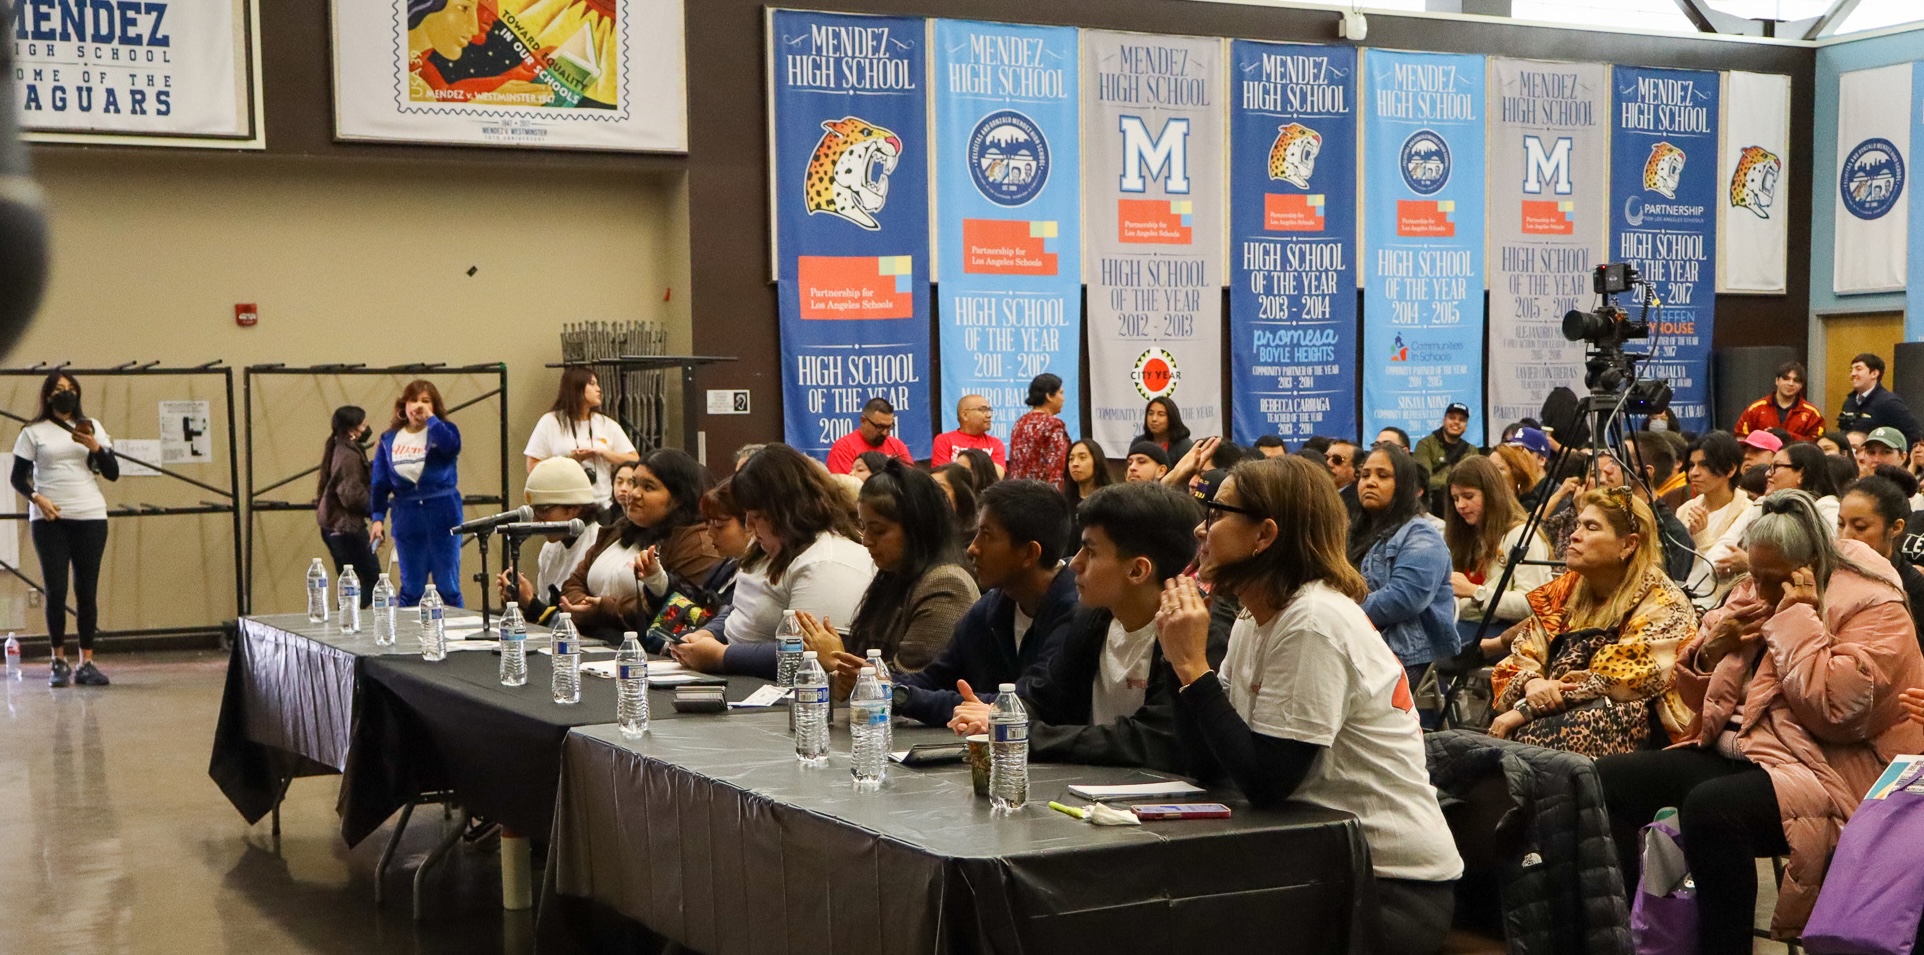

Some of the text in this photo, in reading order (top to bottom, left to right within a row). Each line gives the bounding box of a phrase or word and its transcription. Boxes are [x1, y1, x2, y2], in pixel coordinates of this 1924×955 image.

[503, 9, 588, 91] TOWARD EQUALITY
[811, 23, 889, 59] MENDEZ
[970, 33, 1044, 68] MENDEZ
[77, 46, 170, 62] SCHOOL
[499, 27, 581, 105] IN OUR SCHOOLS
[1120, 44, 1188, 76] MENDEZ
[16, 68, 171, 87] OME OF THE
[409, 50, 423, 97] USA 39
[787, 55, 915, 89] HIGH SCHOOL
[949, 62, 1067, 98] HIGH SCHOOL
[1262, 52, 1328, 85] MENDEZ
[1394, 62, 1456, 93] MENDEZ
[425, 89, 464, 100] MENDEZ
[474, 91, 537, 103] WESTMINSTER
[1099, 72, 1210, 107] HIGH SCHOOL
[1243, 80, 1349, 113] HIGH SCHOOL
[1520, 71, 1578, 99] MENDEZ
[1637, 77, 1693, 106] MENDEZ
[24, 84, 171, 116] AGUARS
[1377, 89, 1476, 120] HIGH SCHOOL
[1502, 96, 1596, 126] HIGH SCHOOL
[1621, 102, 1710, 133] HIGH SCHOOL
[1119, 114, 1190, 194] M
[1522, 135, 1572, 195] M
[1644, 204, 1704, 216] PARTNERSHIP
[1124, 221, 1158, 229] Partnership
[1125, 229, 1180, 238] Los Angeles Schools
[971, 246, 1026, 257] Partnership for
[1243, 242, 1346, 271] HIGH SCHOOL
[1621, 232, 1707, 260] HIGH SCHOOL
[971, 256, 1043, 268] Los Angeles Schools
[1378, 249, 1475, 277] HIGH SCHOOL
[1502, 246, 1592, 273] HIGH SCHOOL
[1643, 259, 1699, 282] THE YEAR
[1101, 258, 1209, 288] HIGH SCHOOL
[1251, 271, 1337, 295] OF THE YEAR
[1509, 274, 1585, 296] OF THE YEAR
[810, 288, 874, 299] Partnership for
[1111, 288, 1200, 312] OF THE YEAR
[1385, 278, 1466, 300] OF THE YEAR
[1668, 283, 1693, 304] 2017
[810, 299, 894, 311] Los Angeles Schools
[954, 296, 1069, 328] HIGH SCHOOL
[1258, 295, 1330, 319] 2013 2014
[1392, 301, 1460, 324] 2014 2015
[1515, 296, 1540, 318] 2015
[1118, 313, 1193, 337] 2012 2013
[965, 327, 1059, 352] OF THE YEAR
[1253, 329, 1339, 354] promesa
[1411, 341, 1463, 351] Communities
[974, 352, 1050, 377] 2011 2012
[1260, 346, 1335, 362] BOYLE HEIGHTS
[1420, 352, 1452, 361] Schools
[797, 353, 919, 386] HIGH SCHOOL
[1130, 371, 1182, 380] CITY YEAR
[1252, 366, 1281, 376] COMMUNITY
[1283, 366, 1306, 376] PARTNER
[1324, 364, 1339, 375] YEAR
[808, 388, 827, 413] OF
[832, 387, 863, 413] THE
[1260, 398, 1293, 413] REBECCA
[1267, 412, 1291, 423] TEACHER
